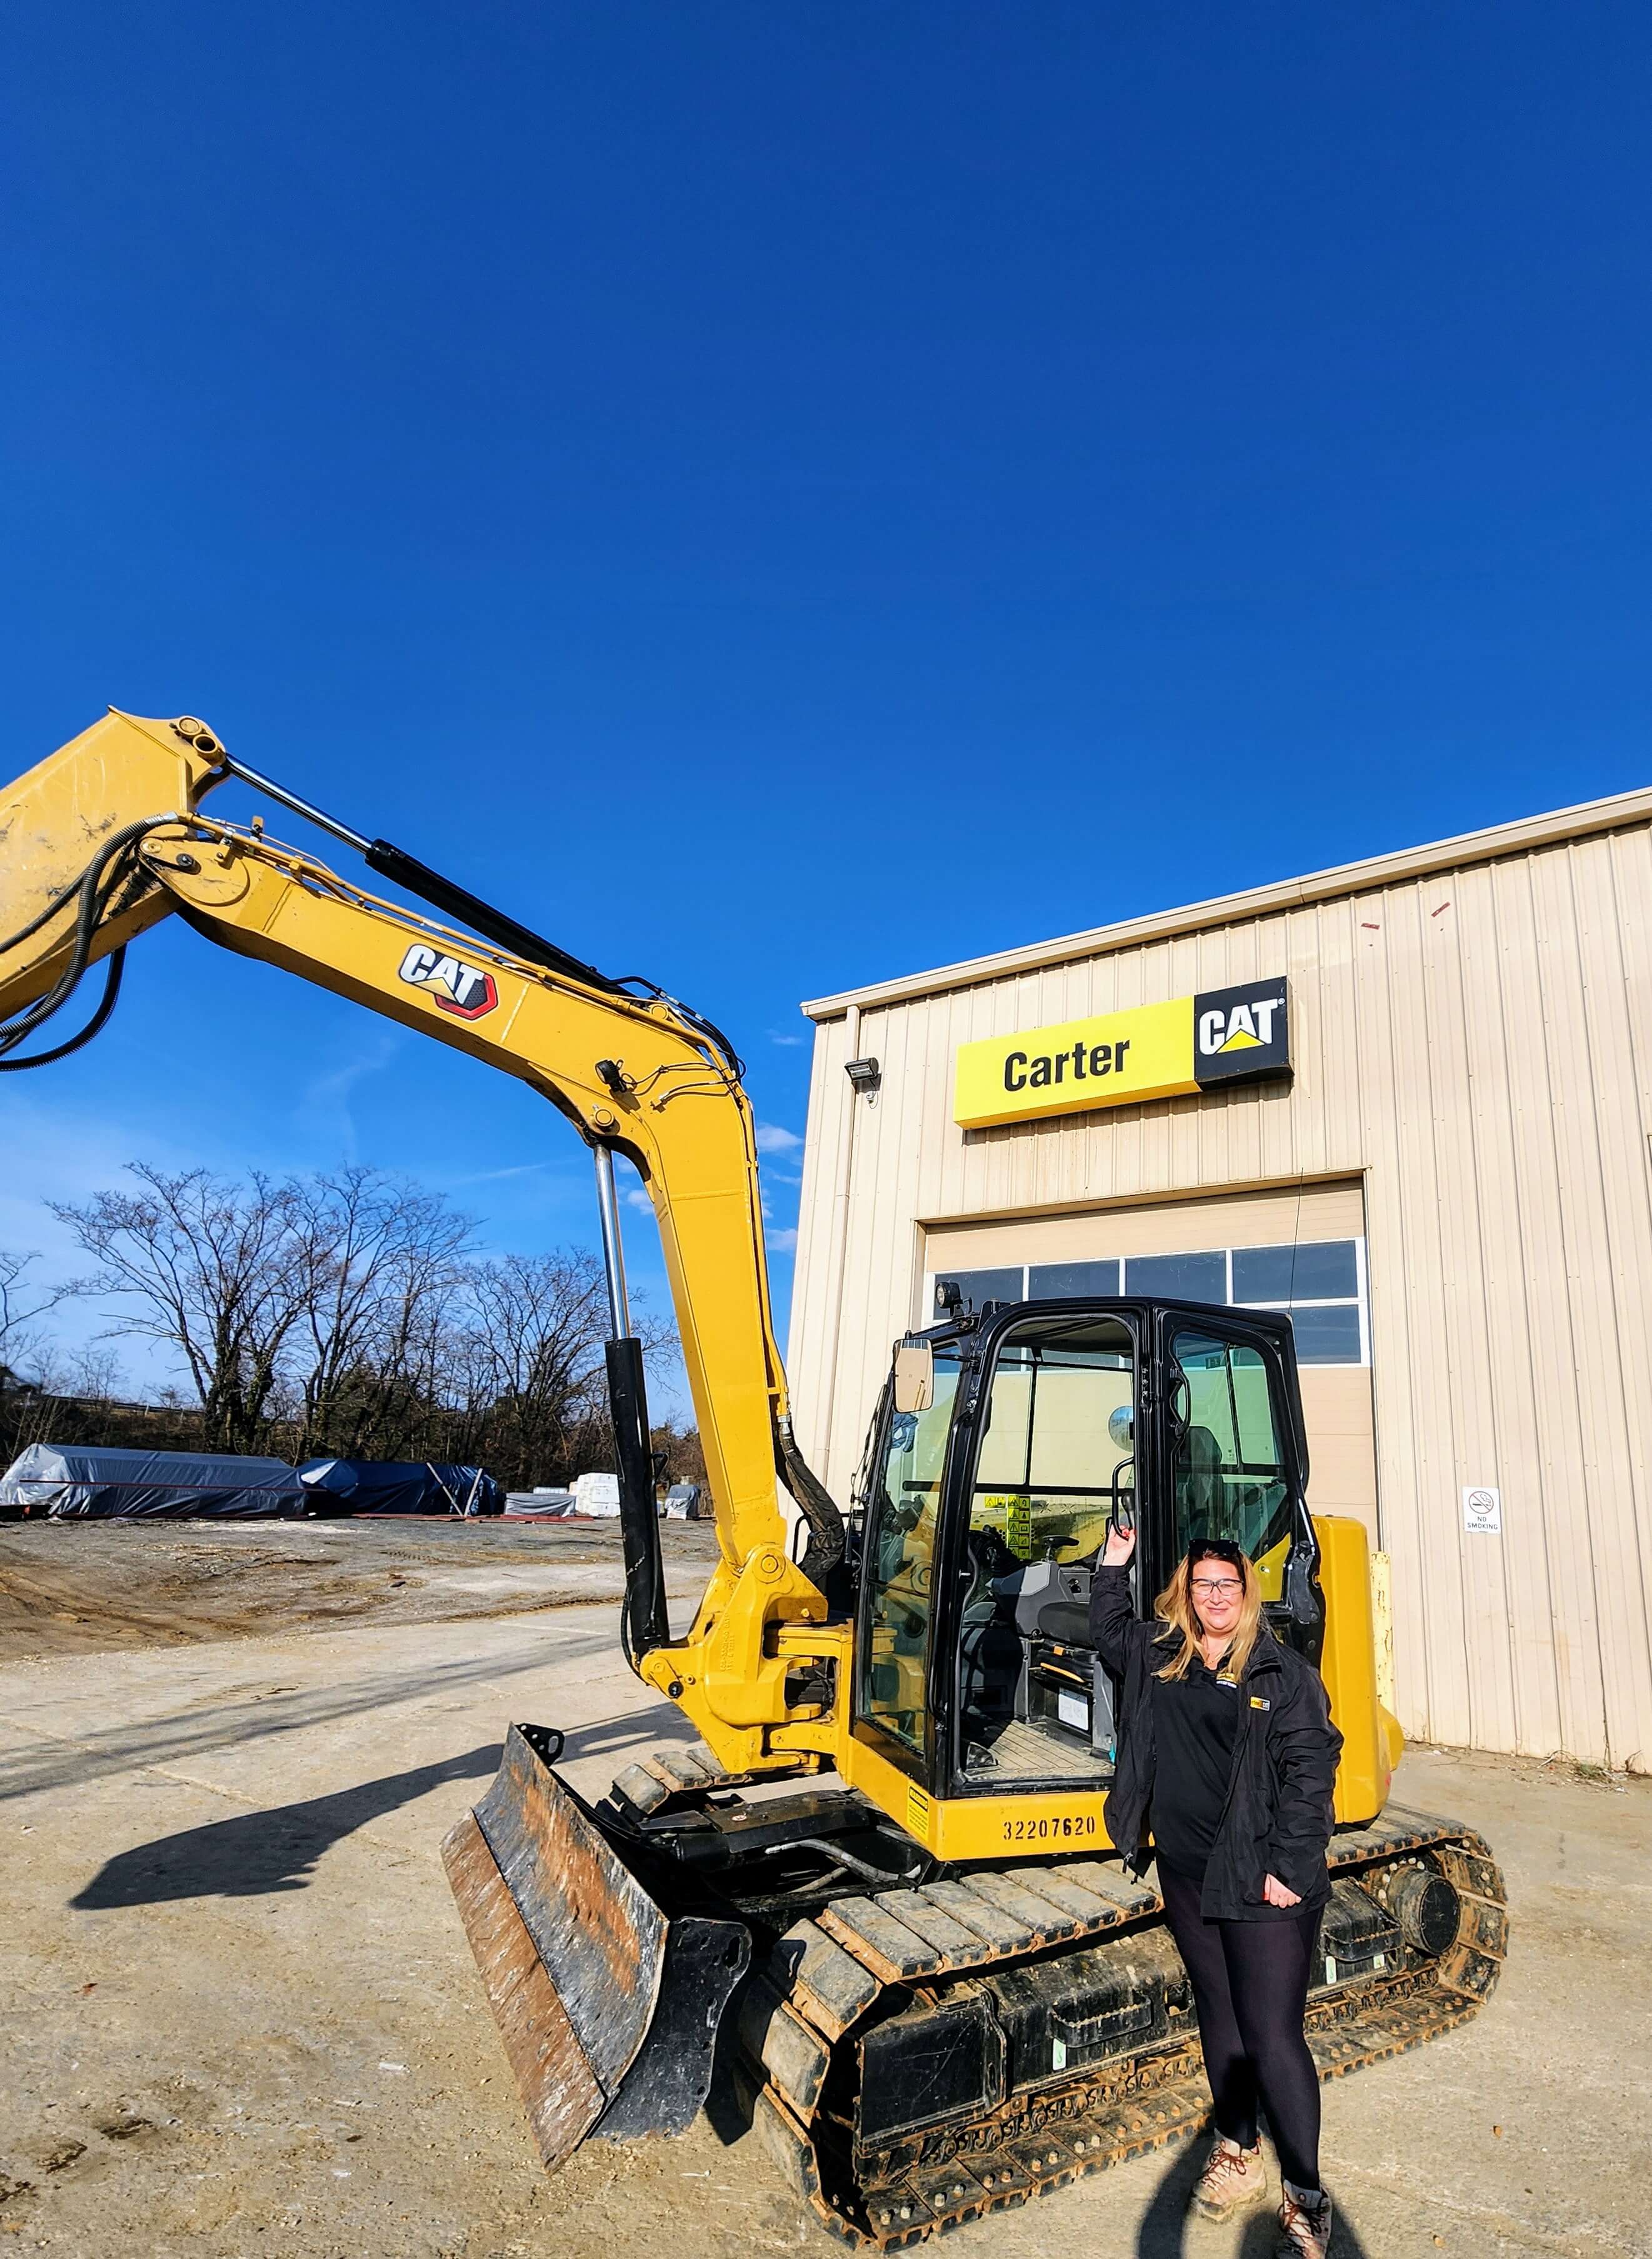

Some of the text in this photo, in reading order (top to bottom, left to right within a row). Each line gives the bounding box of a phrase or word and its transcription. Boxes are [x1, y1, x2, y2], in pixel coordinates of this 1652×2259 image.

[400, 944, 485, 1004] CAT
[1004, 1039, 1130, 1092] Carter
[1467, 1522, 1498, 1530] SMOKING
[1003, 1816, 1095, 1840] 32207620
